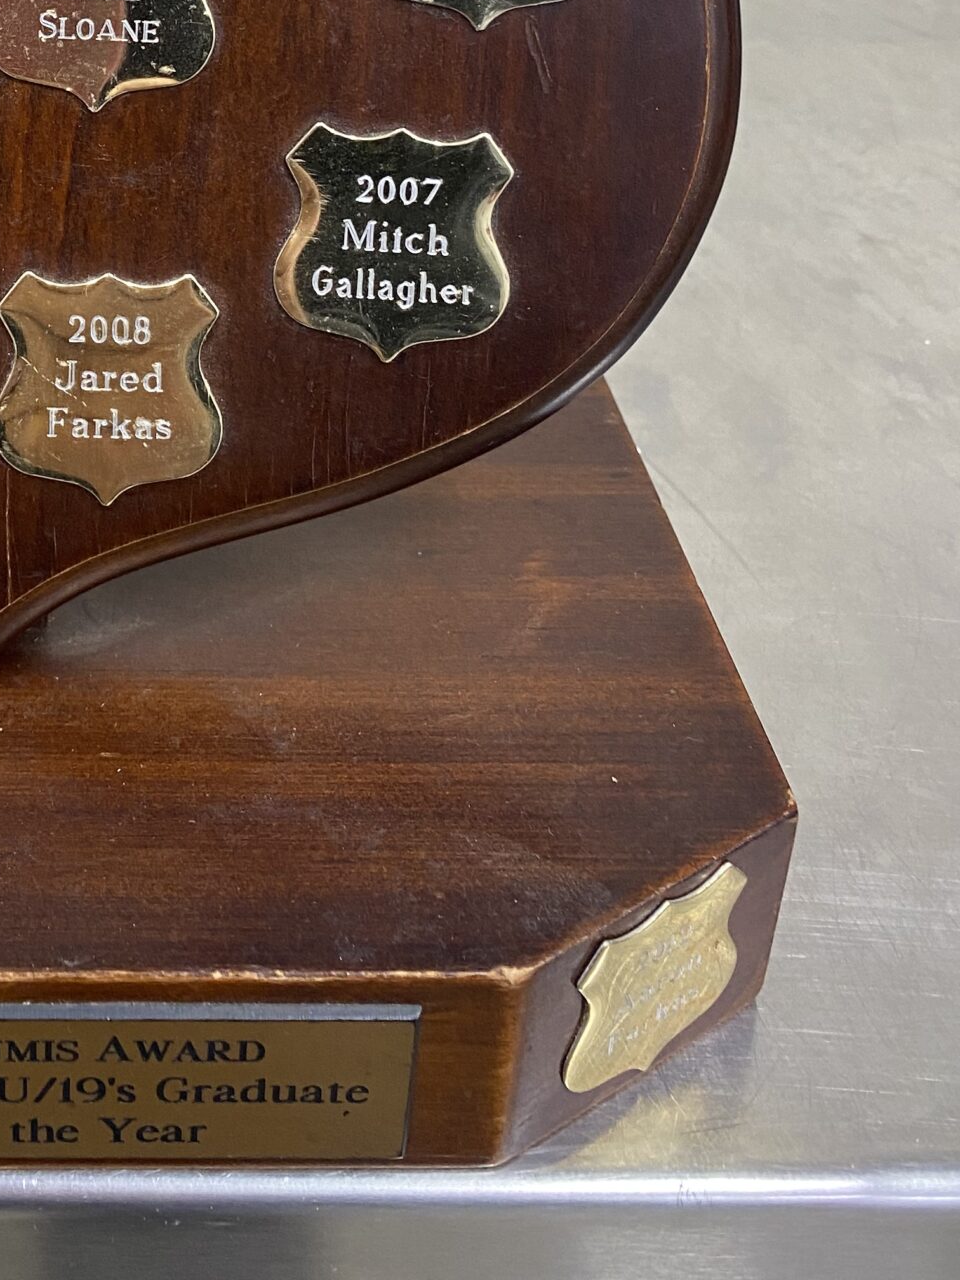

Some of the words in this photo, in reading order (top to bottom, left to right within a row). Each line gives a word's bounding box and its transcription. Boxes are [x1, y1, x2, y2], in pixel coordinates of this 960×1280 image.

[39, 10, 160, 43] SLOANE
[355, 175, 443, 205] 2007
[341, 219, 449, 256] Mitch
[312, 264, 474, 310] Gallagher
[68, 314, 151, 345] 2008
[55, 360, 164, 393] Jared
[46, 407, 171, 440] Farkas
[96, 1035, 266, 1063] AWARD
[156, 1077, 369, 1105] Graduate
[10, 1118, 79, 1144] the
[99, 1117, 208, 1145] Year
